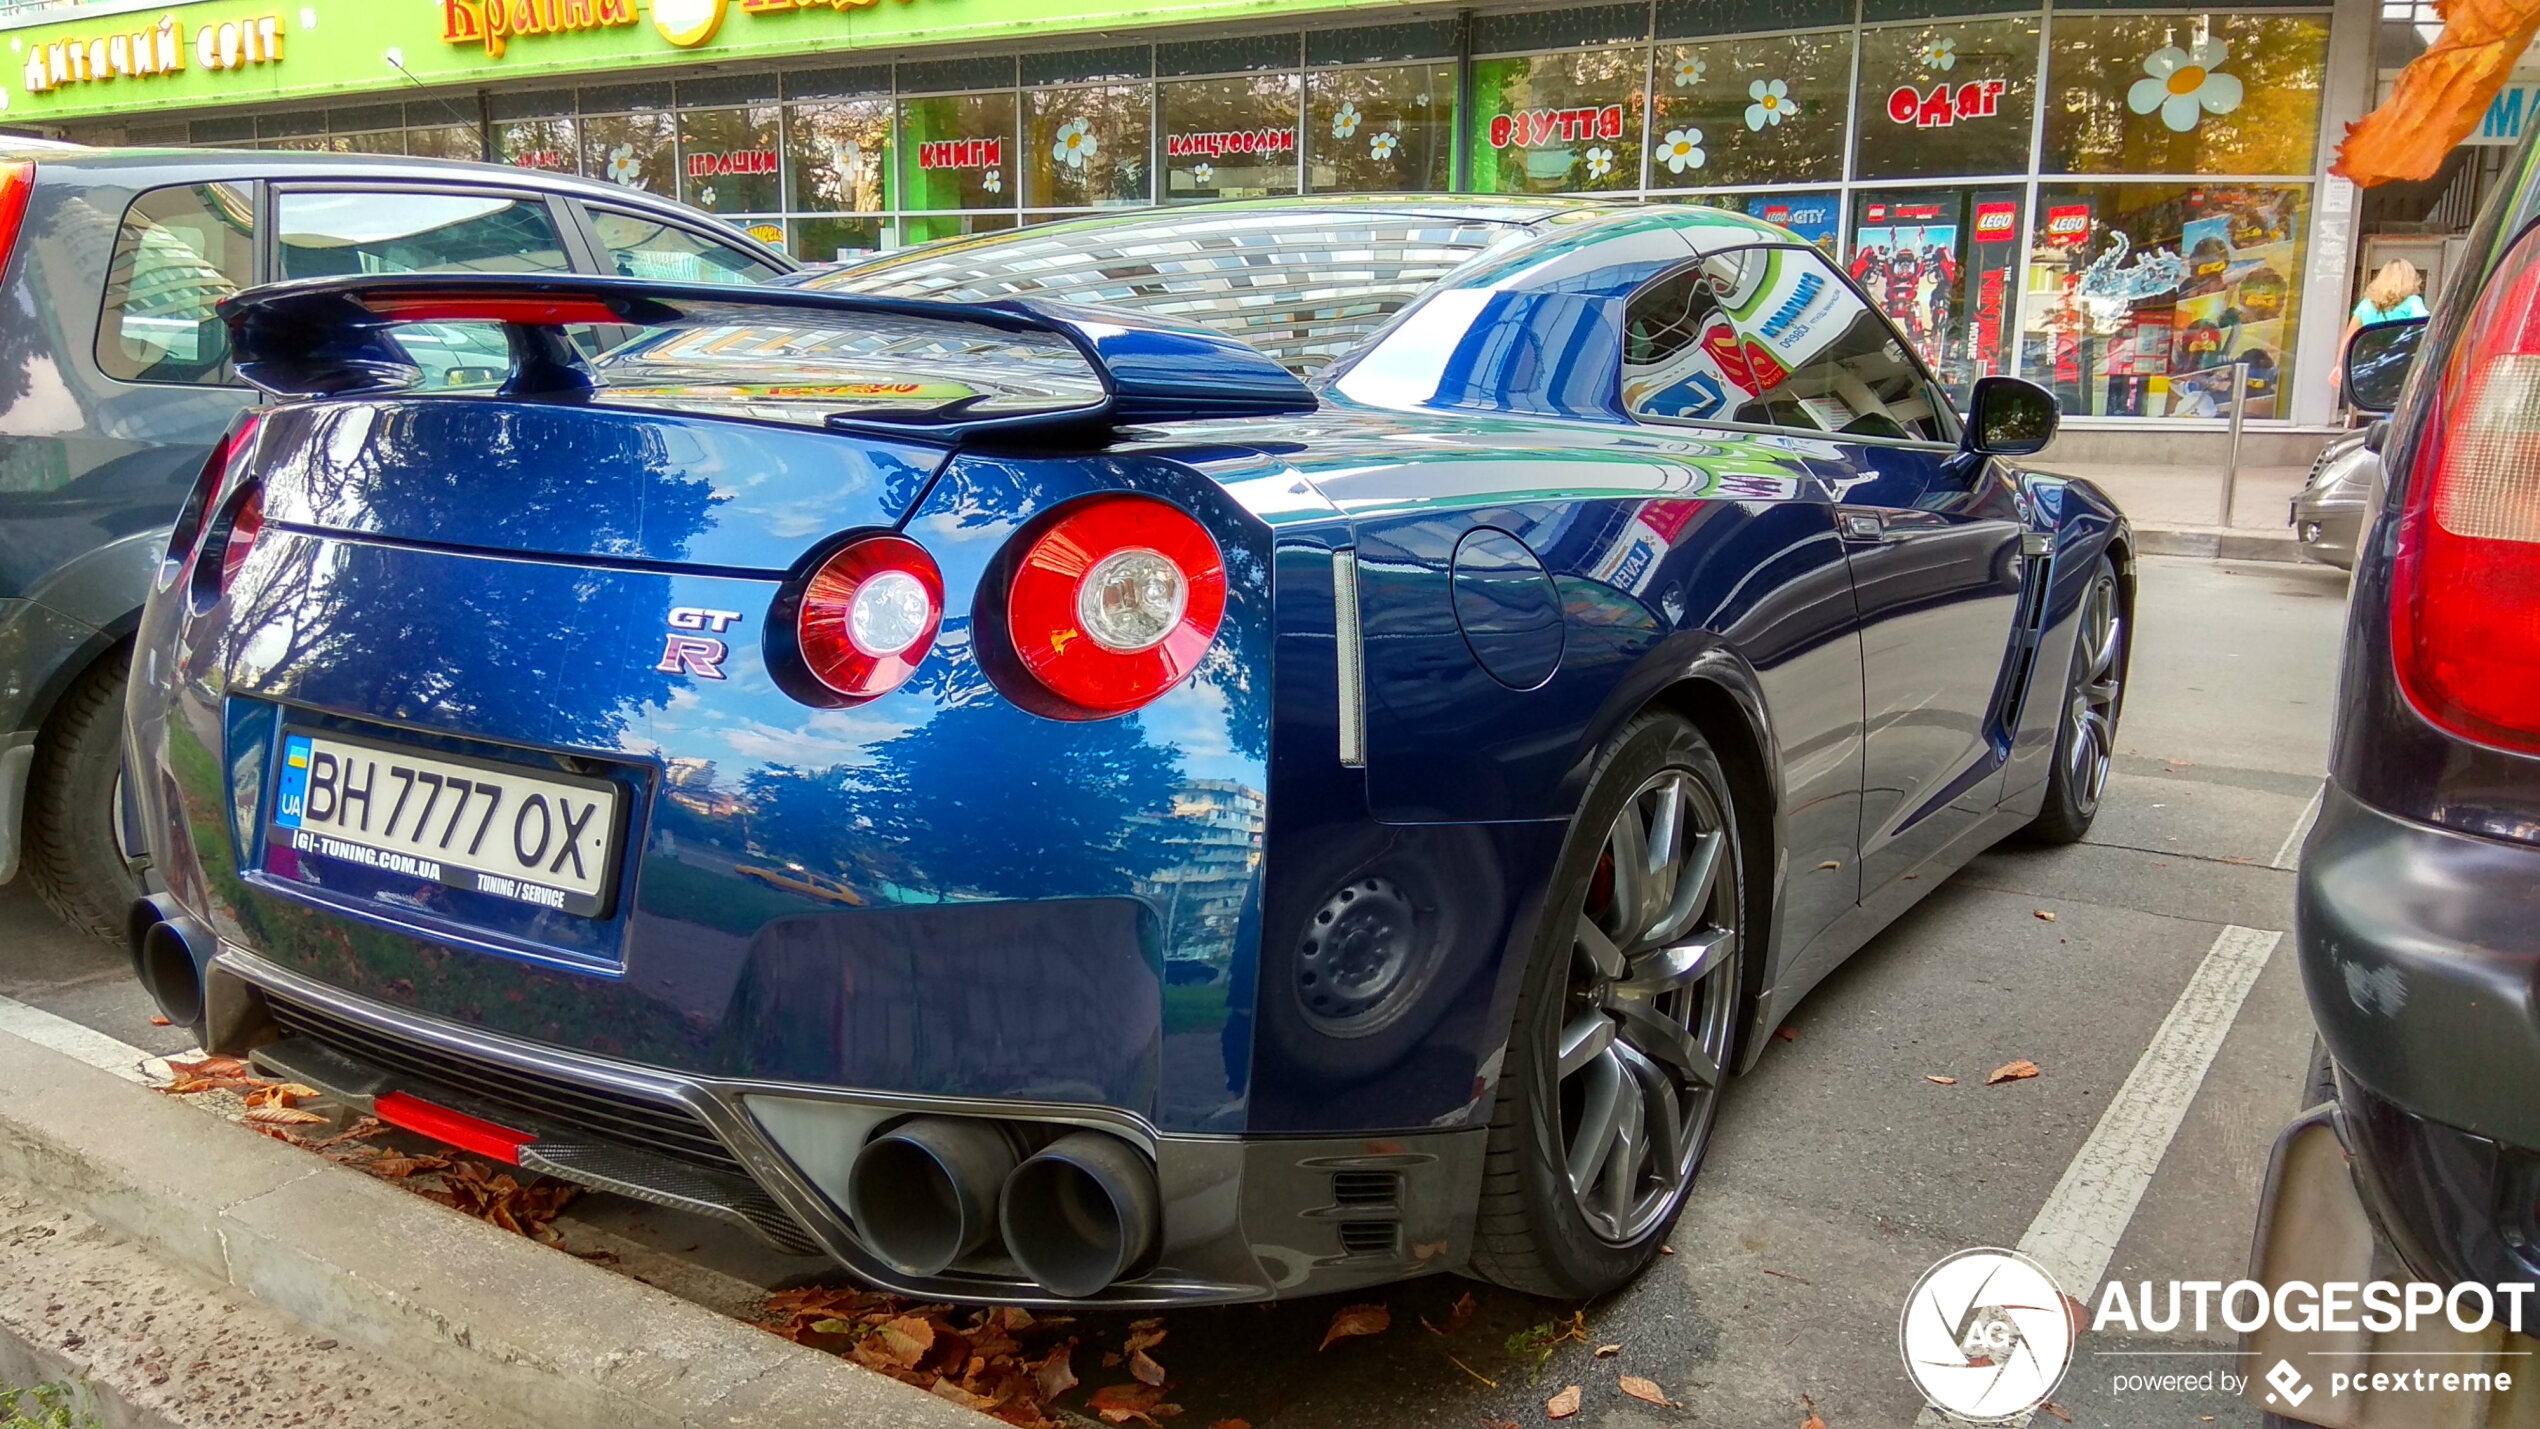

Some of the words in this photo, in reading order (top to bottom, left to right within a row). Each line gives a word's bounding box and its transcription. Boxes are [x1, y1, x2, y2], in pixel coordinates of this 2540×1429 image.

[24, 14, 186, 93] ДИТЯЧИЙ
[1887, 79, 2006, 127] ОДЯГ
[1490, 104, 1622, 148] ВЗУТТЯ
[919, 135, 1001, 169] КНИГИ
[1168, 127, 1294, 158] КАНЦТОВАРИ
[688, 147, 778, 177] ІГРАШКИ
[1766, 213, 1787, 223] LEGO
[1793, 208, 1827, 224] CITY
[1978, 212, 2014, 231] LEGO
[2051, 215, 2088, 233] LEGO
[2003, 265, 2012, 282] THE
[1967, 321, 1980, 360] MOVIE
[668, 607, 742, 632] GT
[656, 633, 729, 680] R
[282, 793, 301, 817] UA
[306, 752, 375, 831] BH
[384, 766, 503, 855] 7777
[514, 793, 596, 879] OX
[477, 874, 515, 898] TUNING
[521, 884, 565, 909] SERVICE
